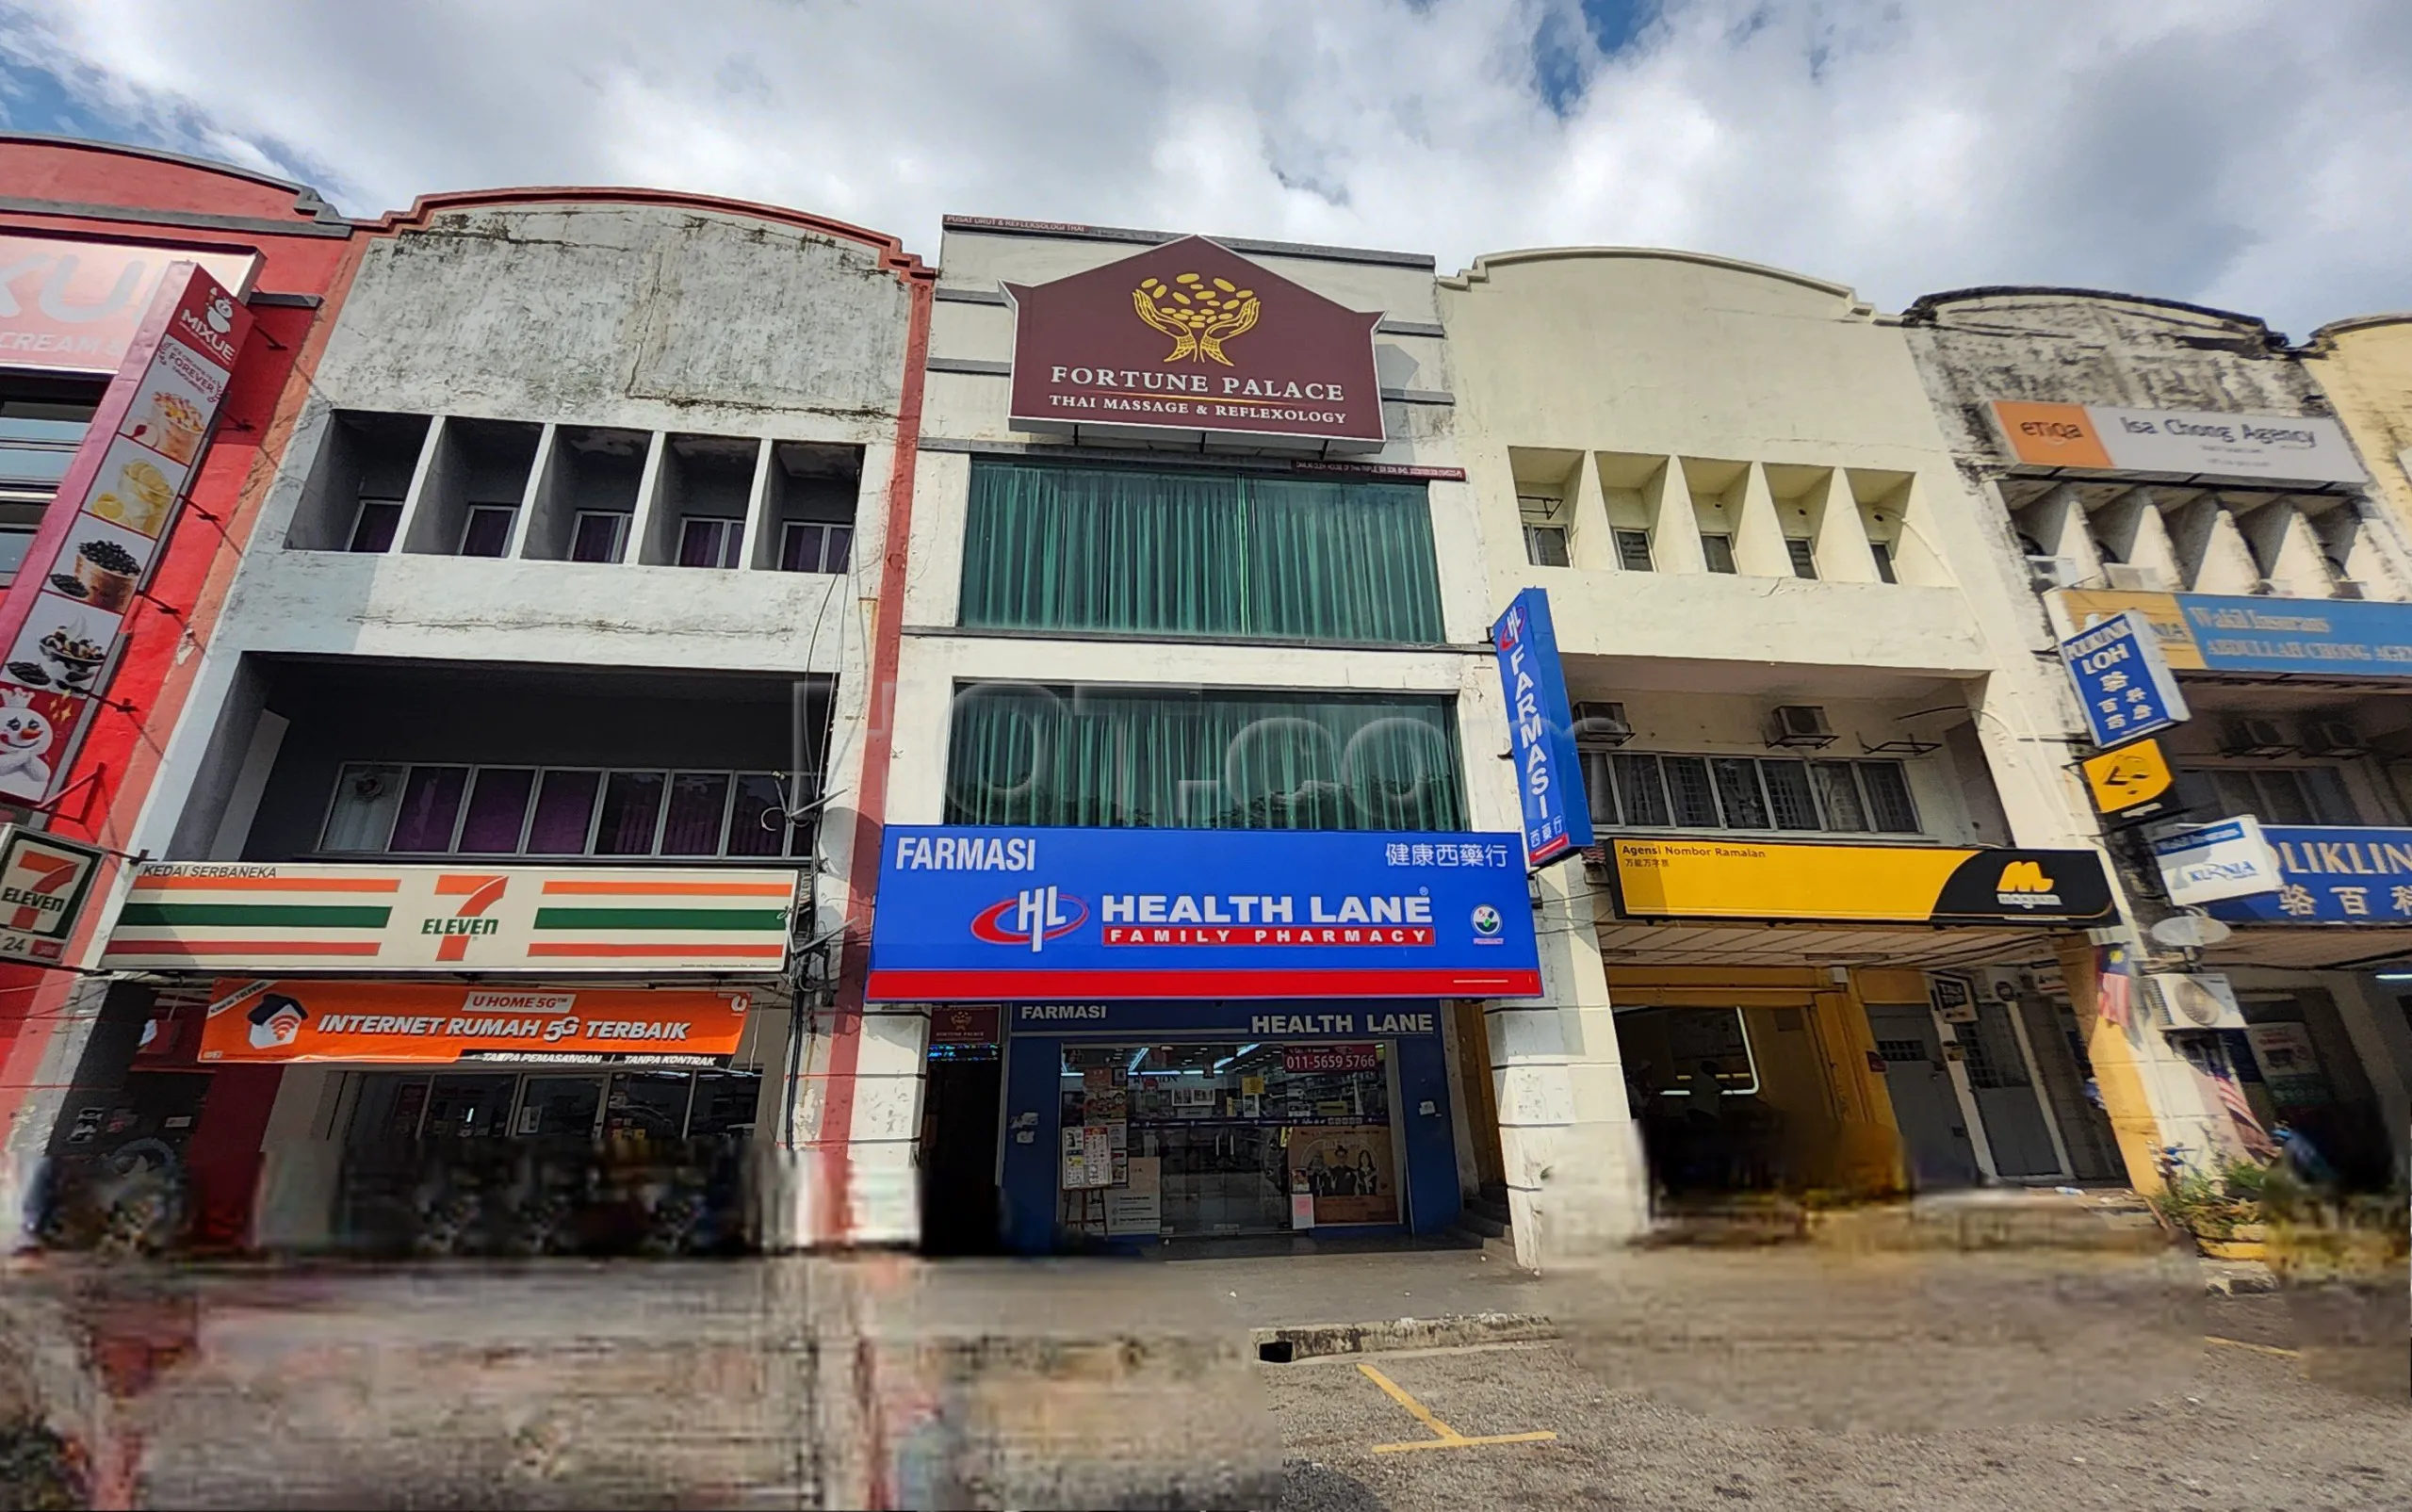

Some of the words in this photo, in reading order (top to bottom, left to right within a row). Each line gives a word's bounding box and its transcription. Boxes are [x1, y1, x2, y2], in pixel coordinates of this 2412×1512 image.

[181, 309, 236, 362] MIXUE
[170, 351, 216, 394] FOREVER
[1050, 365, 1210, 393] FORTUNE
[1222, 376, 1345, 403] PALACE
[1050, 394, 1097, 408] THAI
[1103, 398, 1189, 415] MASSAGE
[1195, 403, 1209, 415] &
[1214, 405, 1348, 425] REFLEXOLOGY
[2163, 418, 2236, 443] Chong
[2241, 423, 2318, 448] Agency
[2080, 642, 2131, 675] LOH
[1510, 643, 1550, 820] FARMASI
[895, 837, 1036, 872] FARMASI
[1385, 842, 1508, 868] 健康西藥行
[1622, 845, 1662, 856] Agensi
[1665, 846, 1712, 856] Nombor
[1715, 847, 1766, 858] Ramalan
[2270, 841, 2412, 875] LIKLIN
[142, 863, 187, 878] KEDAI
[189, 864, 278, 880] SERBANEKA
[434, 875, 510, 962] 7
[1101, 895, 1294, 923] HEALTH
[1111, 930, 1230, 943] FAMILY
[1255, 929, 1426, 944] PHARMACY
[473, 996, 486, 1007] U
[487, 997, 535, 1008] HOME
[1020, 1004, 1107, 1020] FARMASI
[318, 1014, 447, 1035] INTERNET
[445, 1017, 538, 1037] RUMAH
[543, 1016, 580, 1043] 5G
[586, 1020, 691, 1041] TERBAIK
[1252, 1014, 1354, 1034] HEALTH
[1366, 1013, 1434, 1033] LANE
[482, 1051, 521, 1063] TANPA
[521, 1052, 602, 1065] PEMASANGAN
[624, 1054, 661, 1065] TANPA
[661, 1055, 717, 1066] KONTRAK
[1286, 1055, 1344, 1069] 011-5659
[1345, 1054, 1376, 1068] 5766
